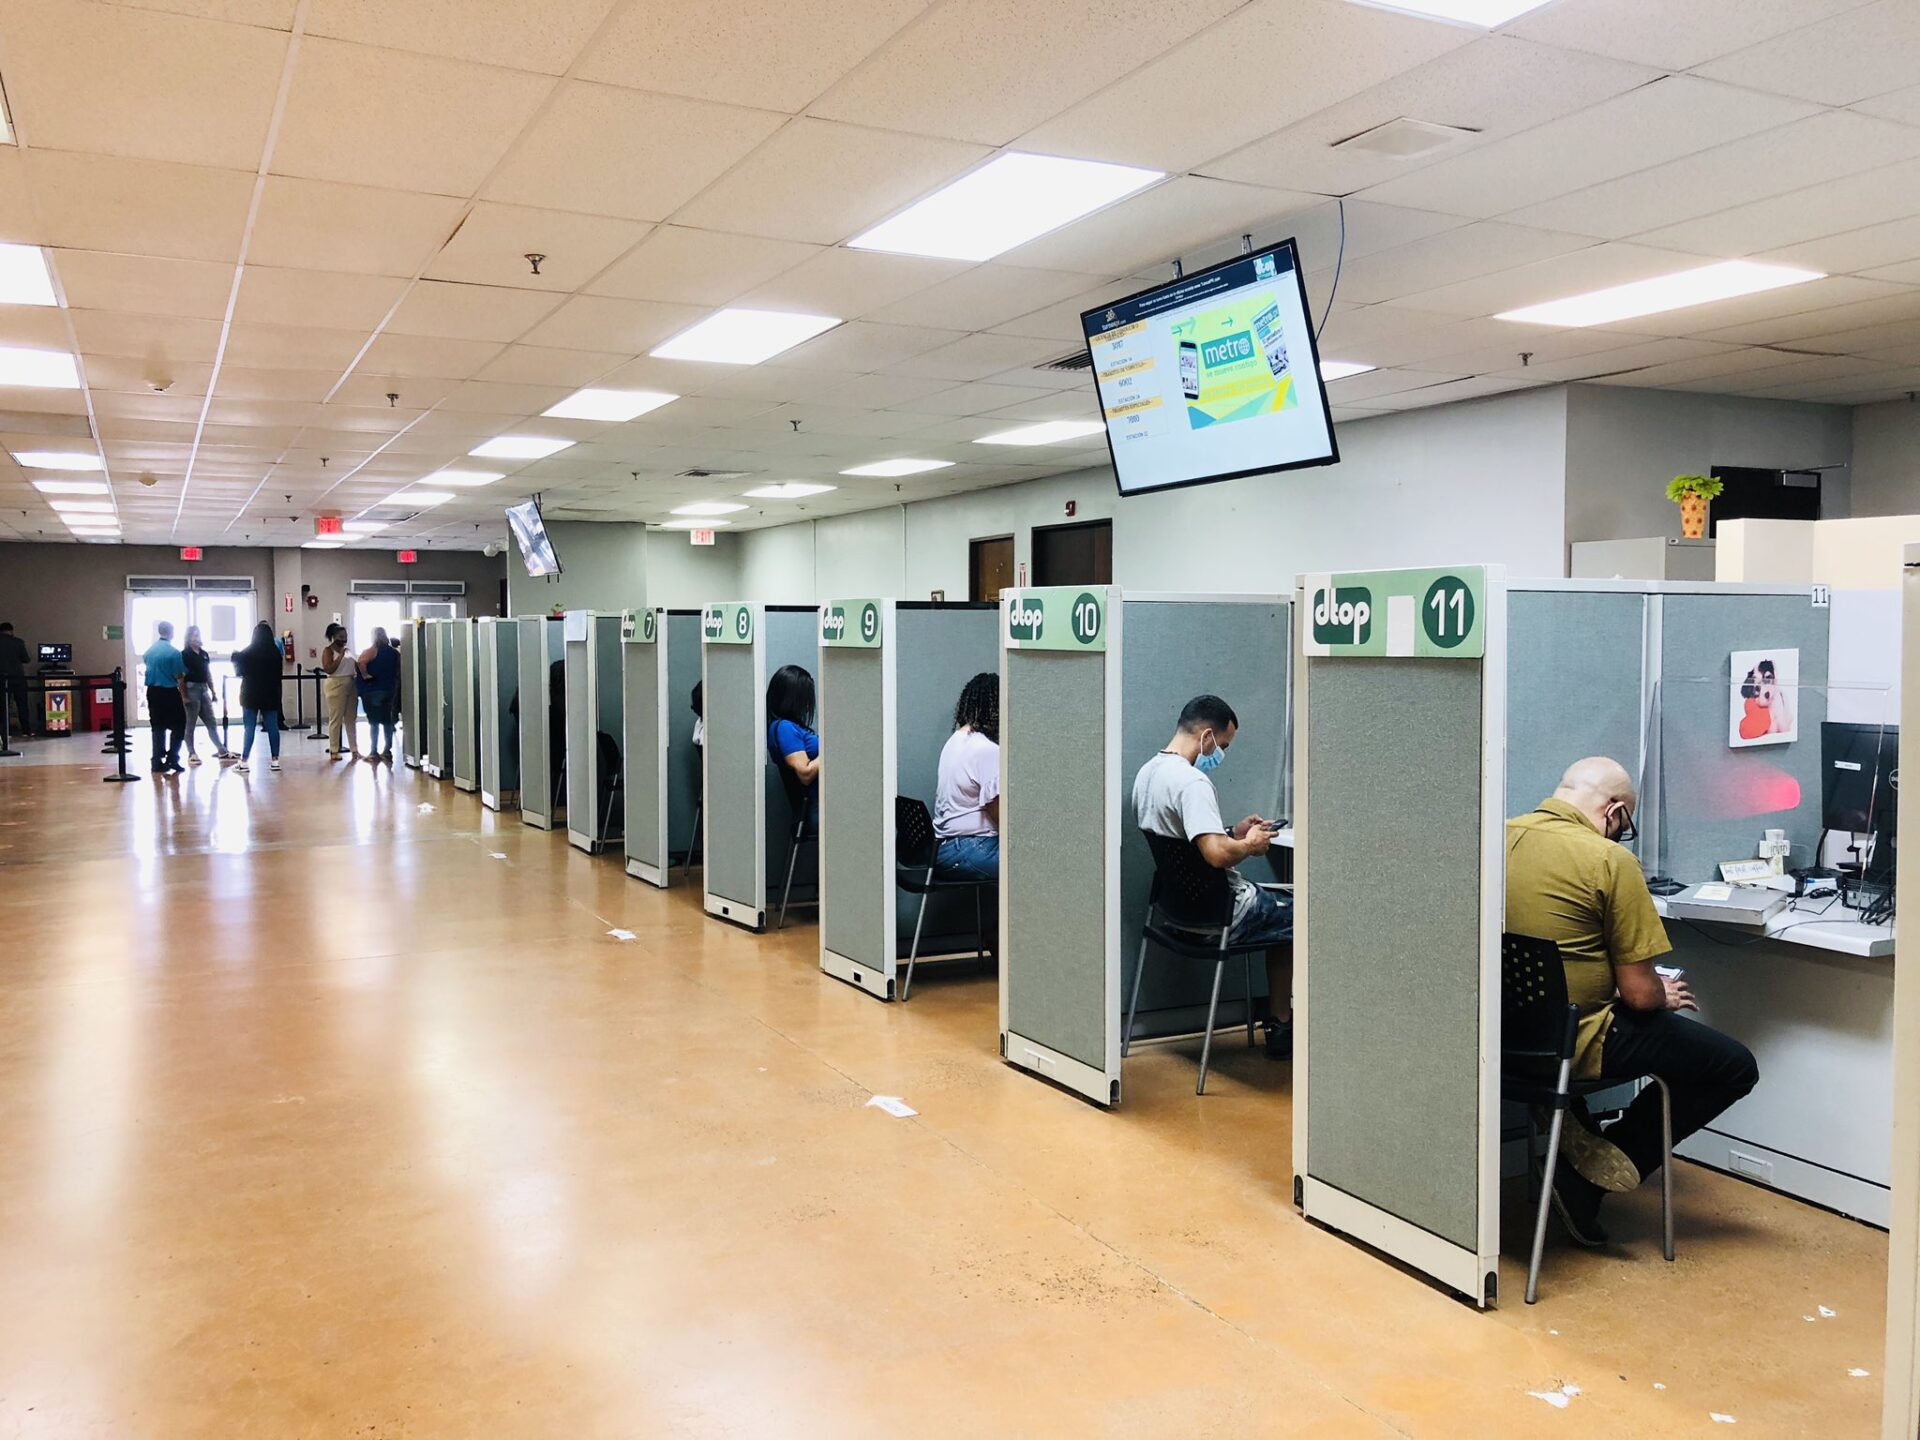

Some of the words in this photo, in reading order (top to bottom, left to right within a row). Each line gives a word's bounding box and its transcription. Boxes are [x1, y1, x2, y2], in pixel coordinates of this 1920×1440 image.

[1205, 337, 1251, 365] metro
[696, 530, 712, 543] EXIT
[1813, 587, 1828, 604] 11
[646, 616, 653, 635] 7
[739, 612, 748, 634] 8
[824, 607, 845, 639] dtop
[864, 609, 874, 636] 9
[1010, 597, 1043, 641] dtop
[1075, 597, 1097, 637] 10
[1314, 587, 1370, 645] dtop
[1430, 589, 1467, 637] 11
